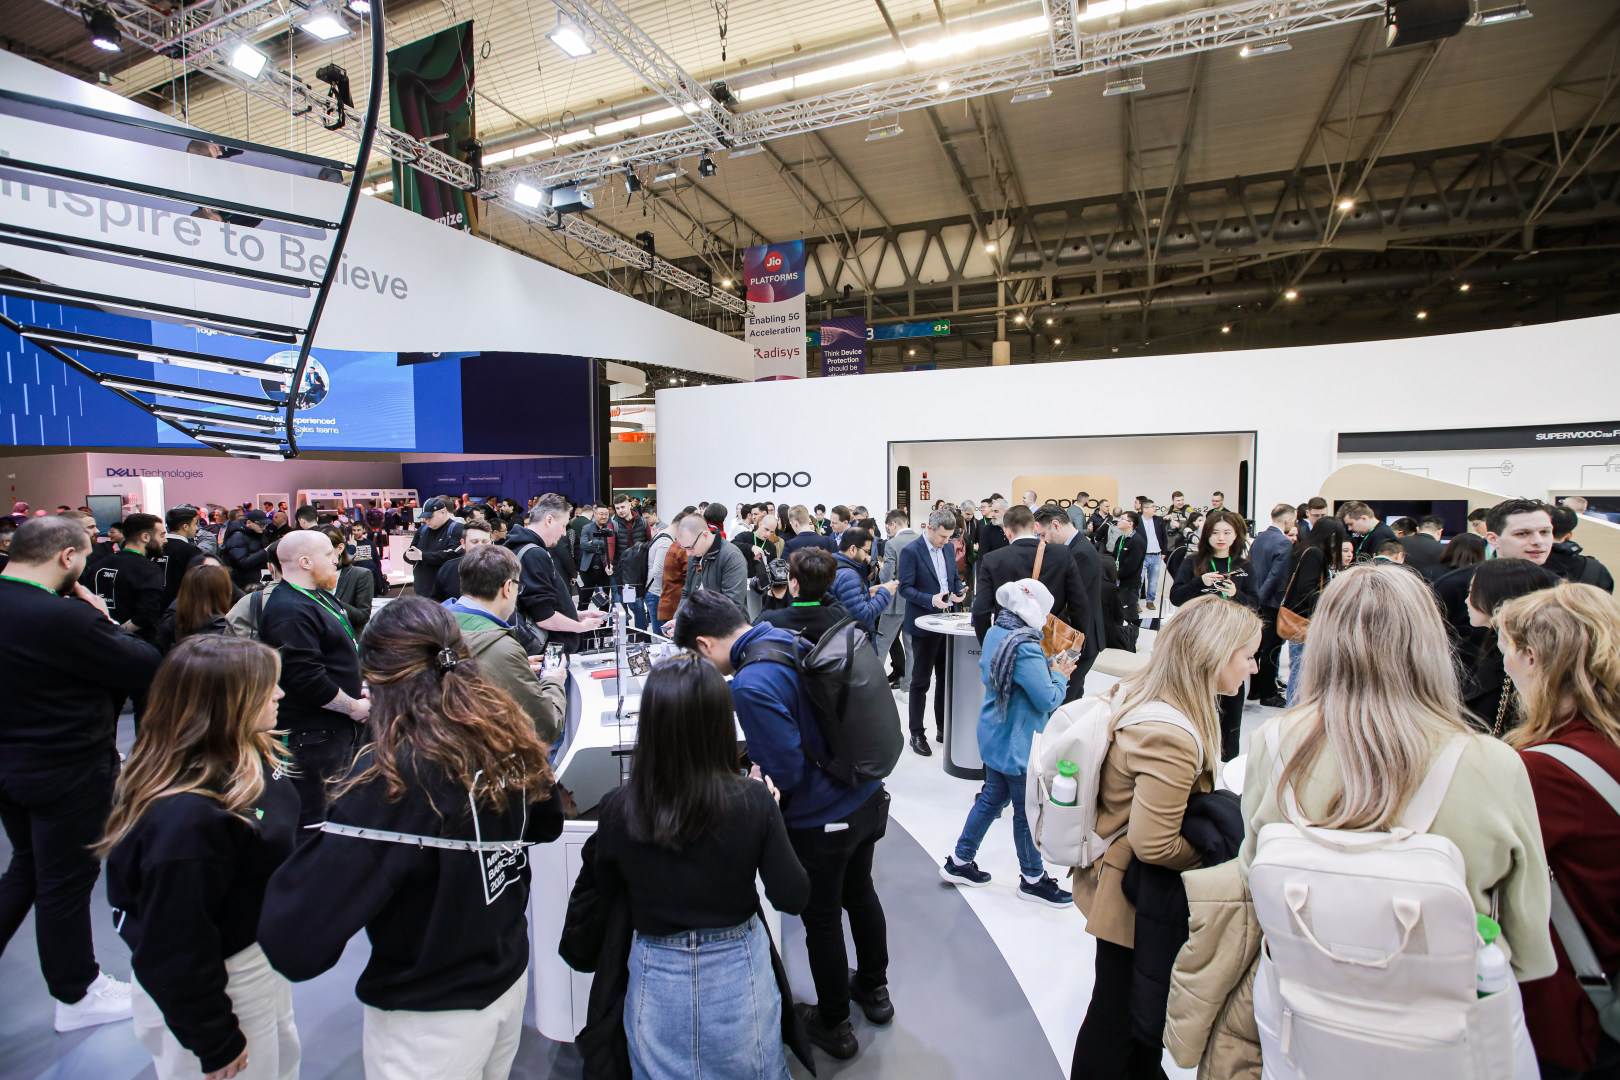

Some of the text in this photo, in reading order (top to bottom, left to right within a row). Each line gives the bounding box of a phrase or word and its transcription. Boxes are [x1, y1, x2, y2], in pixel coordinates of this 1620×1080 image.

[219, 221, 265, 262] to
[766, 256, 782, 267] Jio
[750, 272, 799, 285] PLATFORMS
[749, 312, 800, 325] Enabling 5G
[749, 325, 801, 337] Acceleration
[841, 348, 862, 356] Device
[827, 356, 860, 365] Protection
[828, 364, 848, 372] should
[292, 417, 336, 425] xperienced
[106, 467, 204, 480] DELL Technologies
[734, 471, 812, 492] oppo
